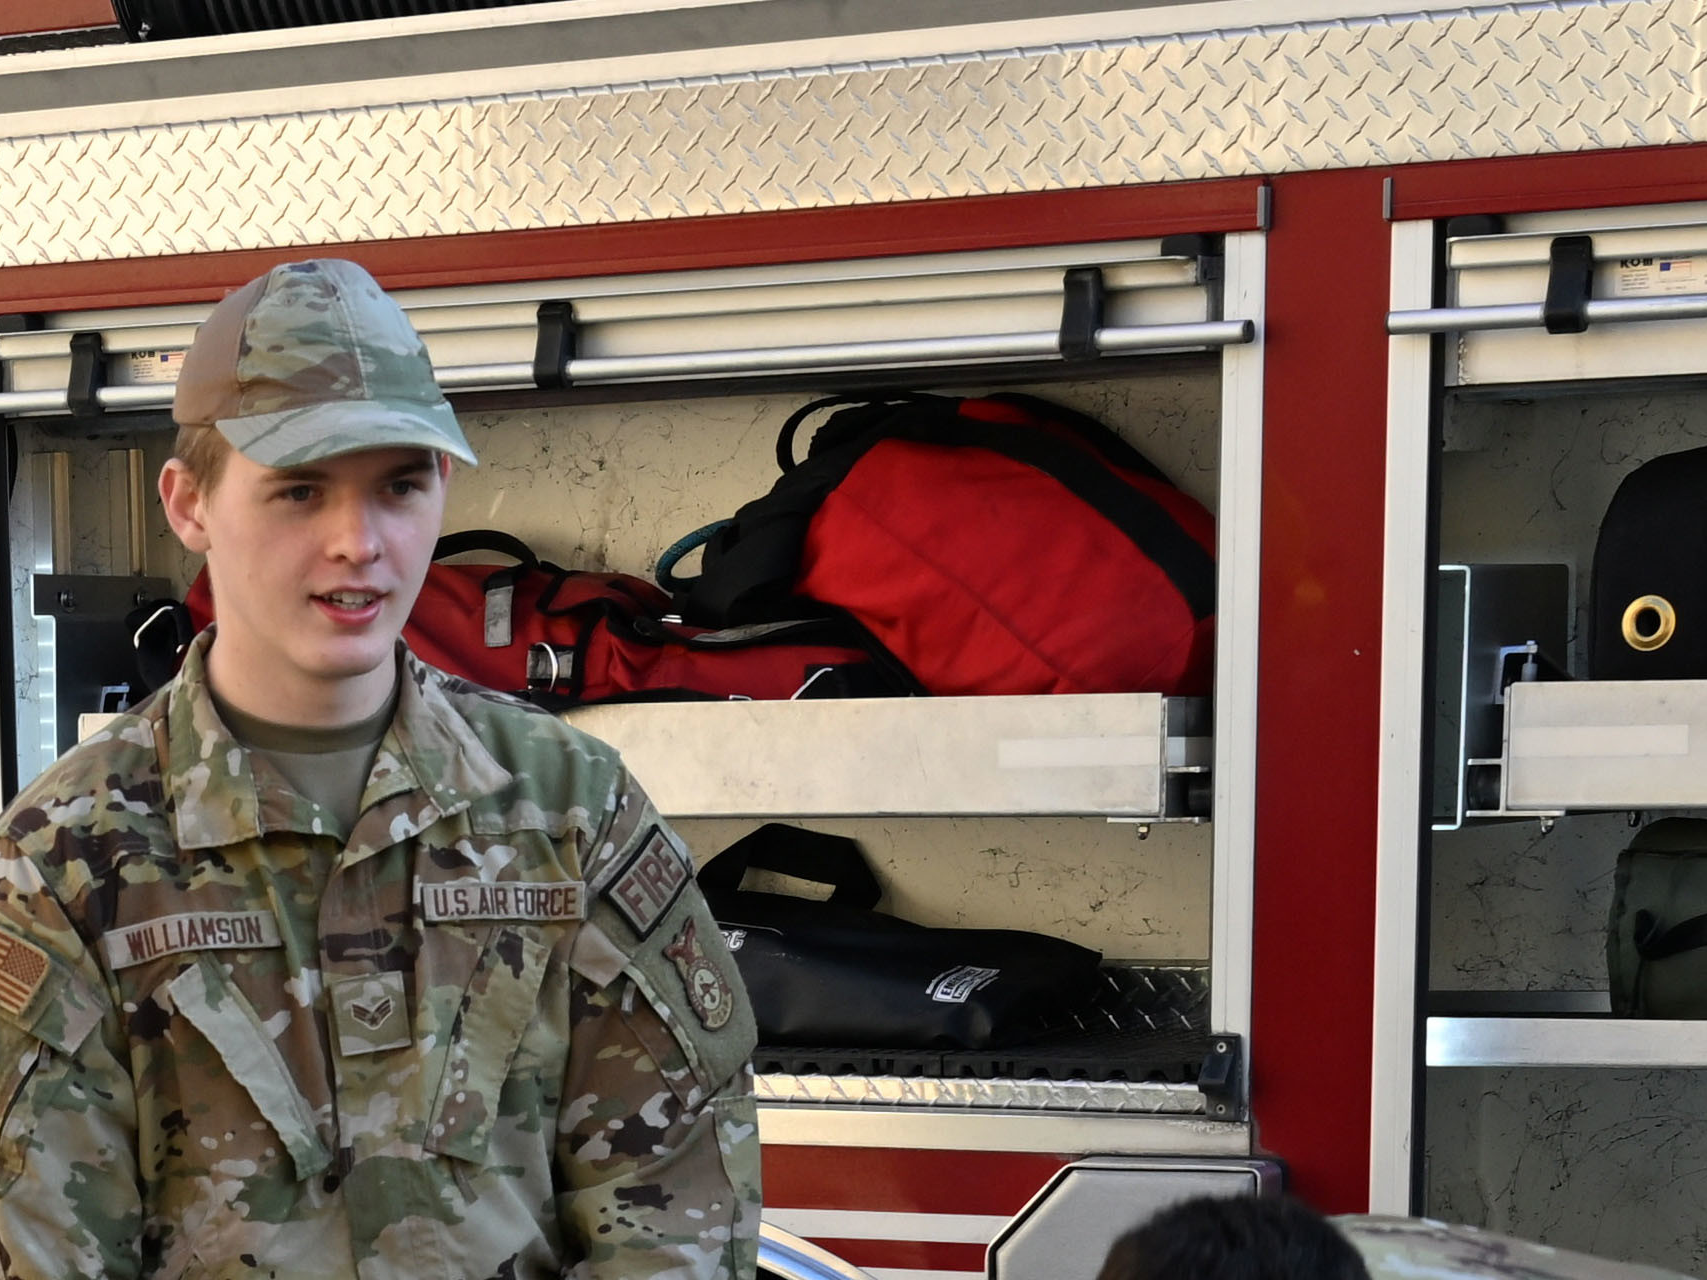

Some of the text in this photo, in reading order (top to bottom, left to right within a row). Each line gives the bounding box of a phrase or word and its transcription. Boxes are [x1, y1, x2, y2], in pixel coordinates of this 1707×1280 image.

[434, 887, 576, 916] U.S. AIR FORCE
[616, 839, 685, 925] FIRE
[126, 916, 262, 961] WILLIAMSON
